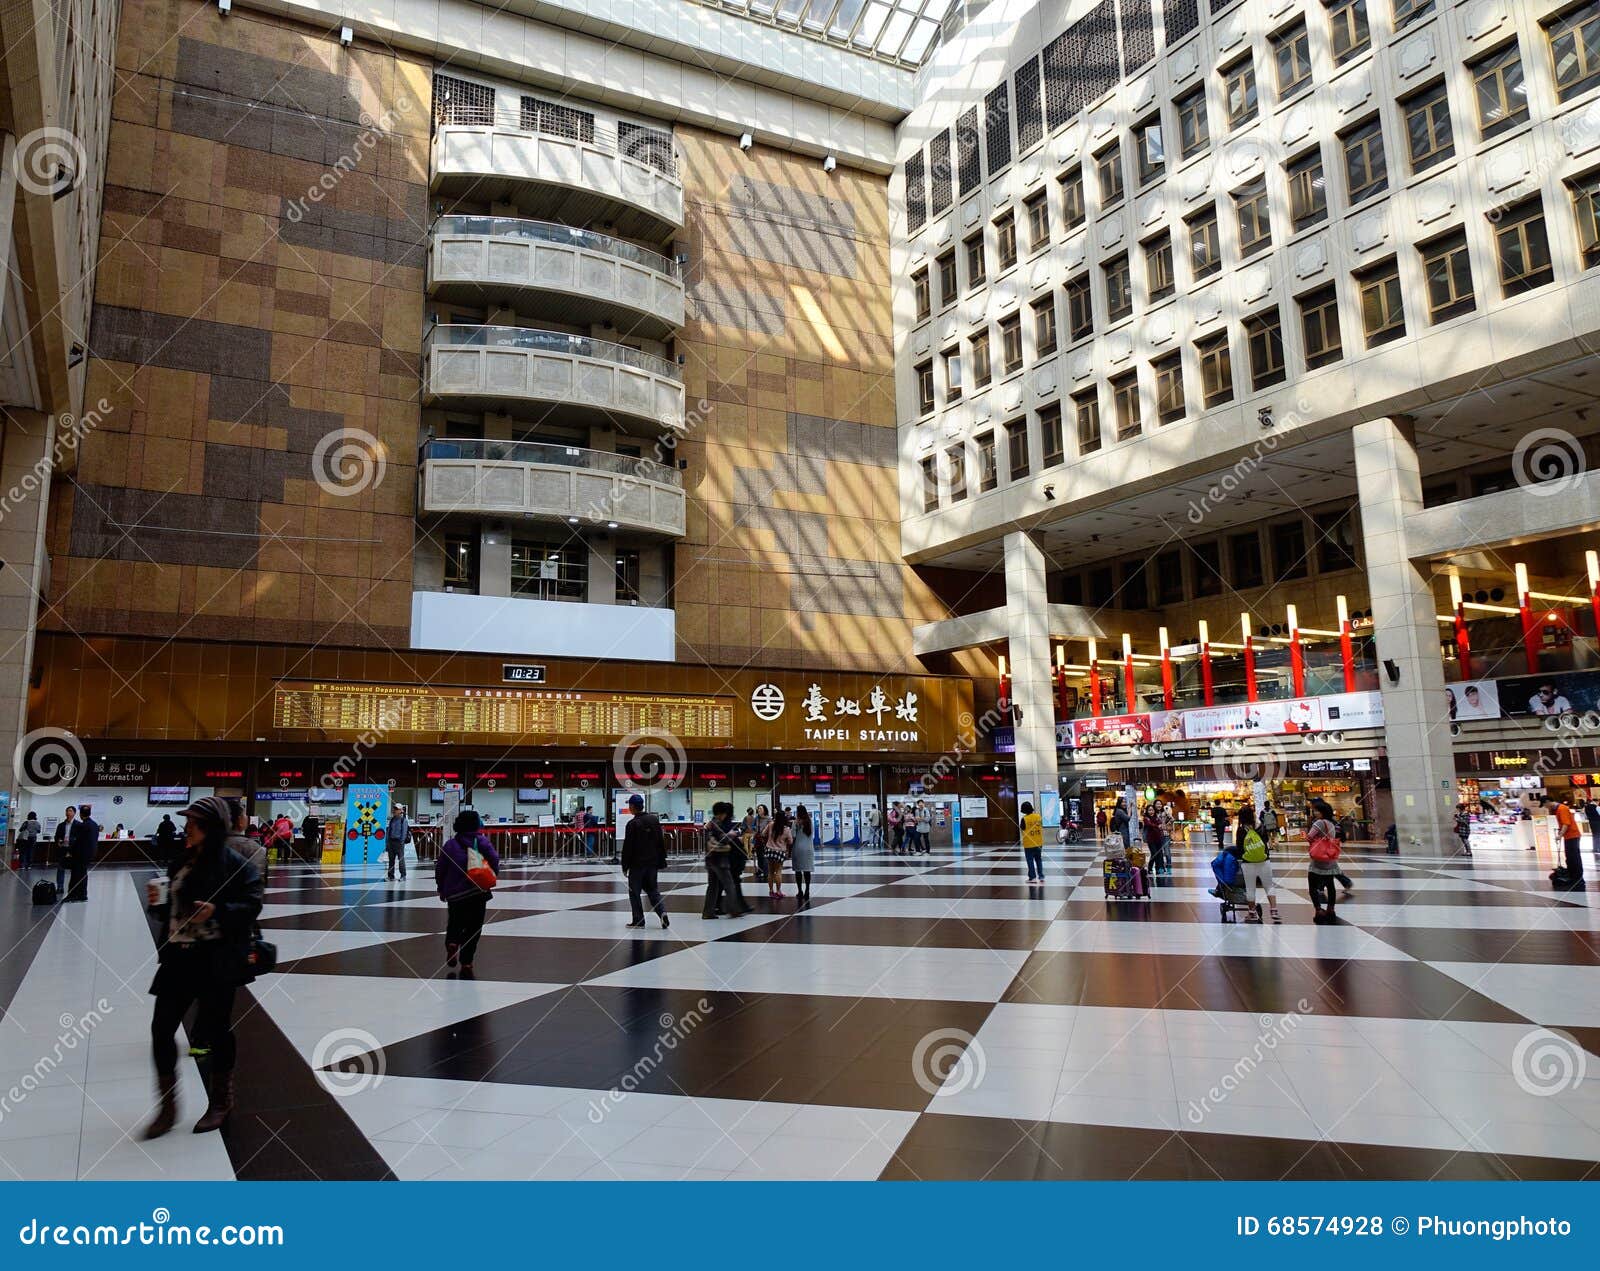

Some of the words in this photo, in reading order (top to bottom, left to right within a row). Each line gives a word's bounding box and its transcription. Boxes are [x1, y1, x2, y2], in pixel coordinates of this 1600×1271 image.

[511, 668, 540, 679] 10:23
[801, 683, 918, 726] 臺北車站
[804, 728, 849, 740] TAIPEI
[860, 730, 918, 742] STATION
[1494, 756, 1528, 765] Breeze
[93, 763, 151, 772] 服務中心
[98, 773, 143, 781] Information
[1308, 785, 1322, 793] LINE
[1323, 784, 1350, 792] FRIENDS
